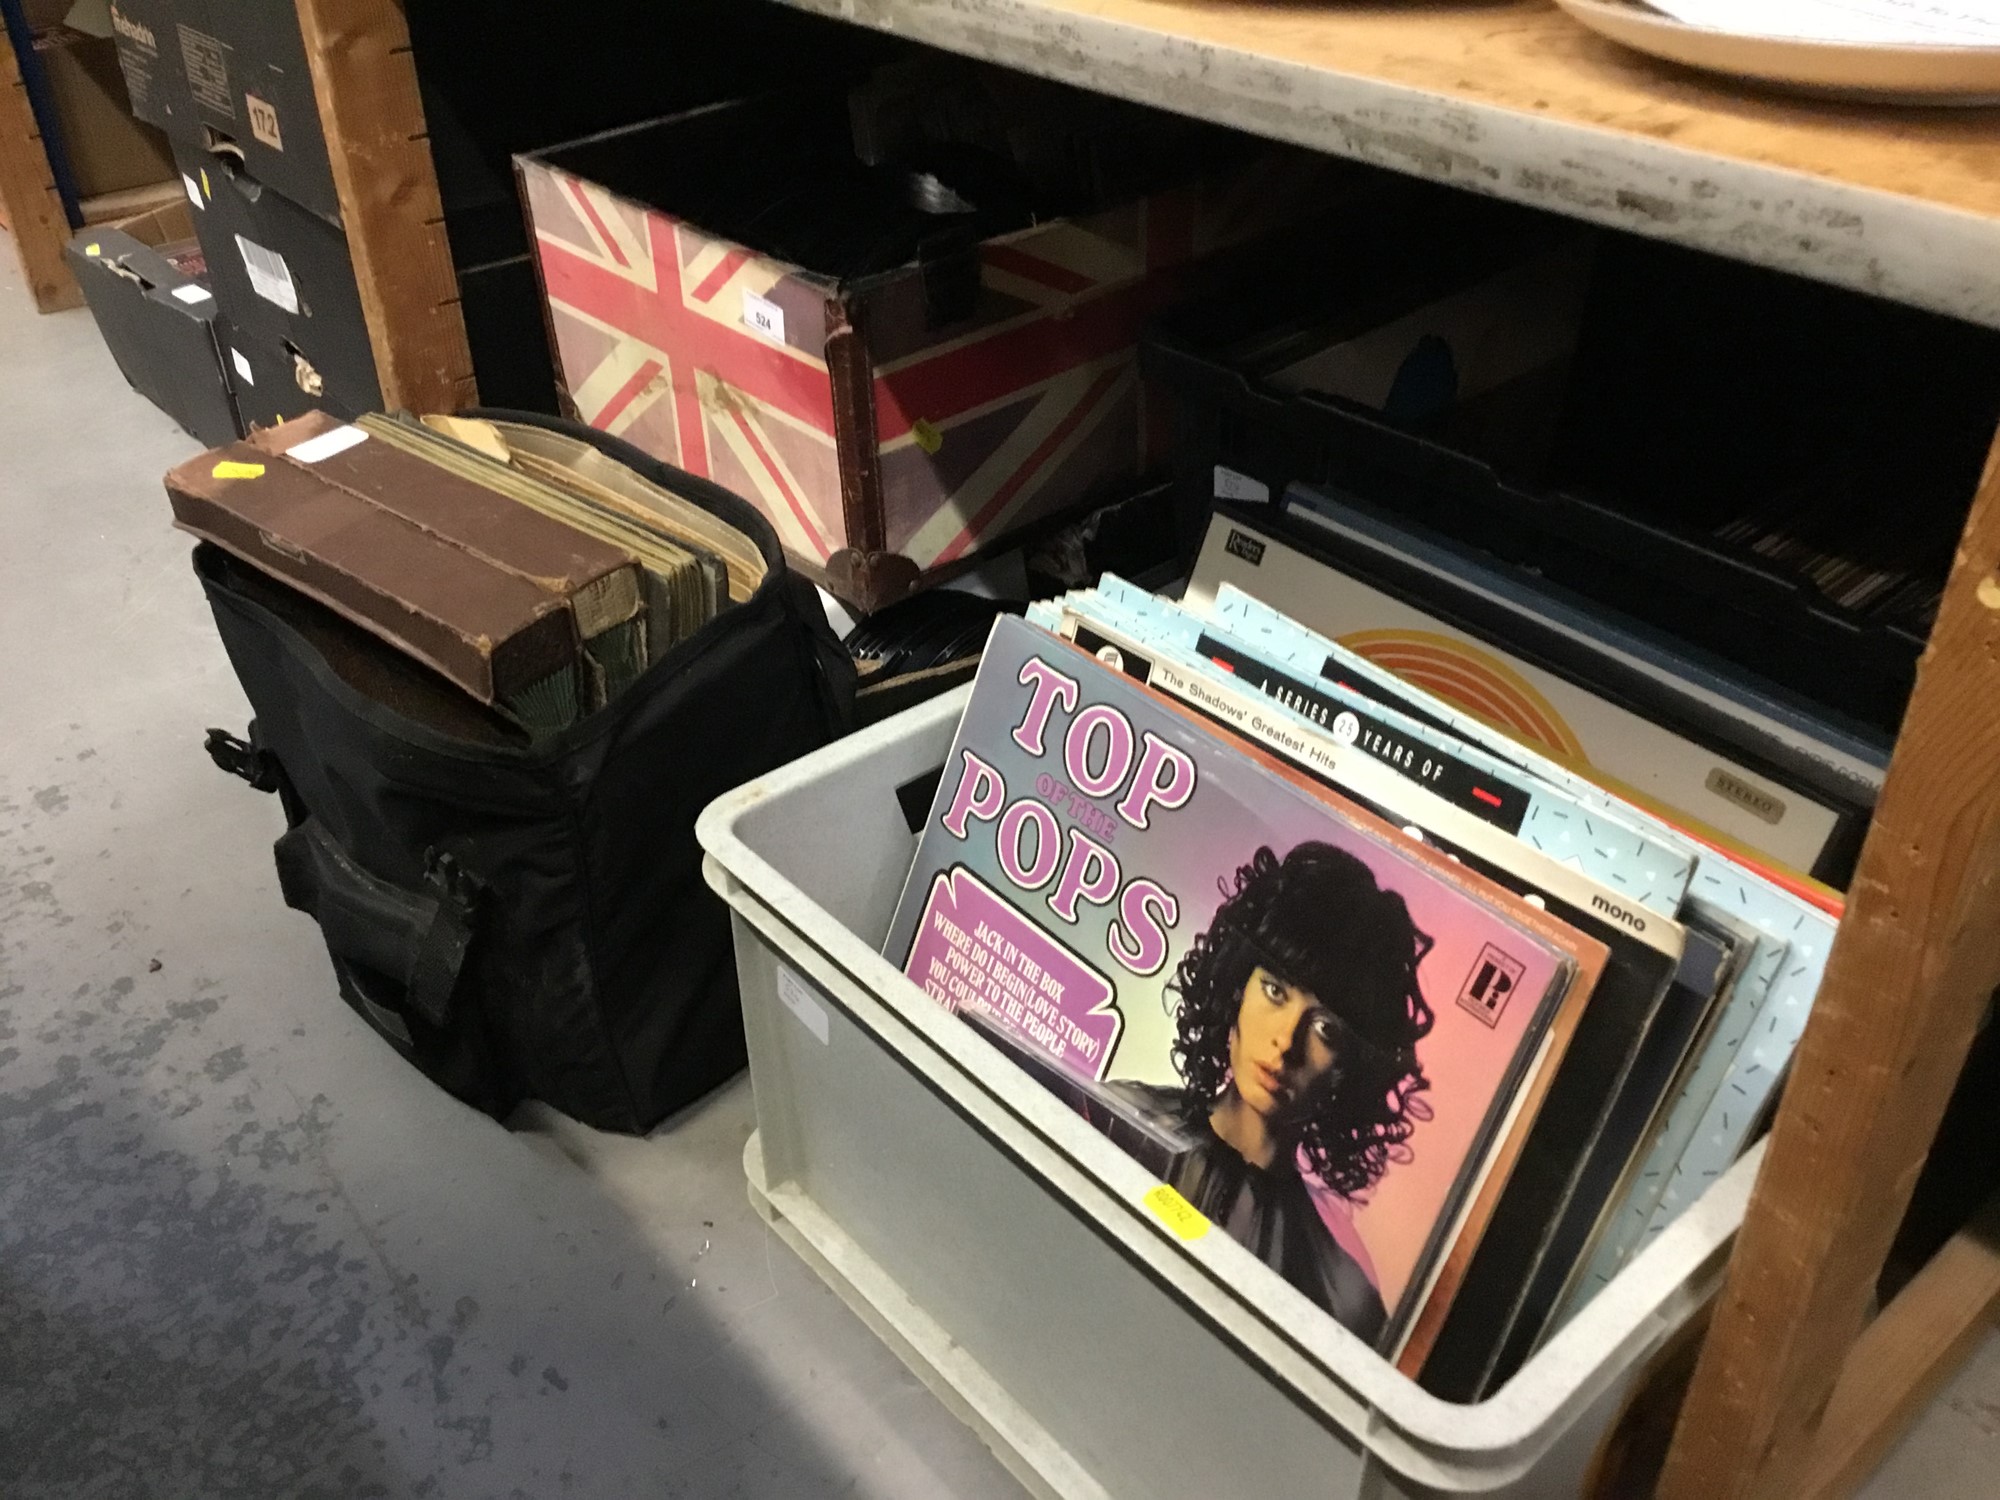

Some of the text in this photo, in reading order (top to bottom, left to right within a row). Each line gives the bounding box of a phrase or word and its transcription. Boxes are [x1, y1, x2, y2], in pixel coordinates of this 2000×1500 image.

[755, 311, 771, 330] 524
[1012, 655, 1197, 830] TOP
[1163, 668, 1336, 770] The Shadows' Greatest Hits
[1258, 679, 1444, 781] A SERIES 25 YEARS OF
[1036, 772, 1118, 844] OF THE
[941, 748, 1180, 977] POPS
[1591, 894, 1646, 932] mono
[928, 956, 952, 985] YOU
[933, 910, 973, 951] WHERE
[970, 943, 989, 968] DO
[986, 953, 995, 973] I
[1056, 1015, 1101, 1063] STORY)
[945, 946, 986, 988] POWER
[985, 977, 1001, 1002] TO
[999, 991, 1026, 1022] THE
[1023, 1010, 1068, 1059] PEOPLE
[974, 920, 1066, 1004] JACK IN THE BOX
